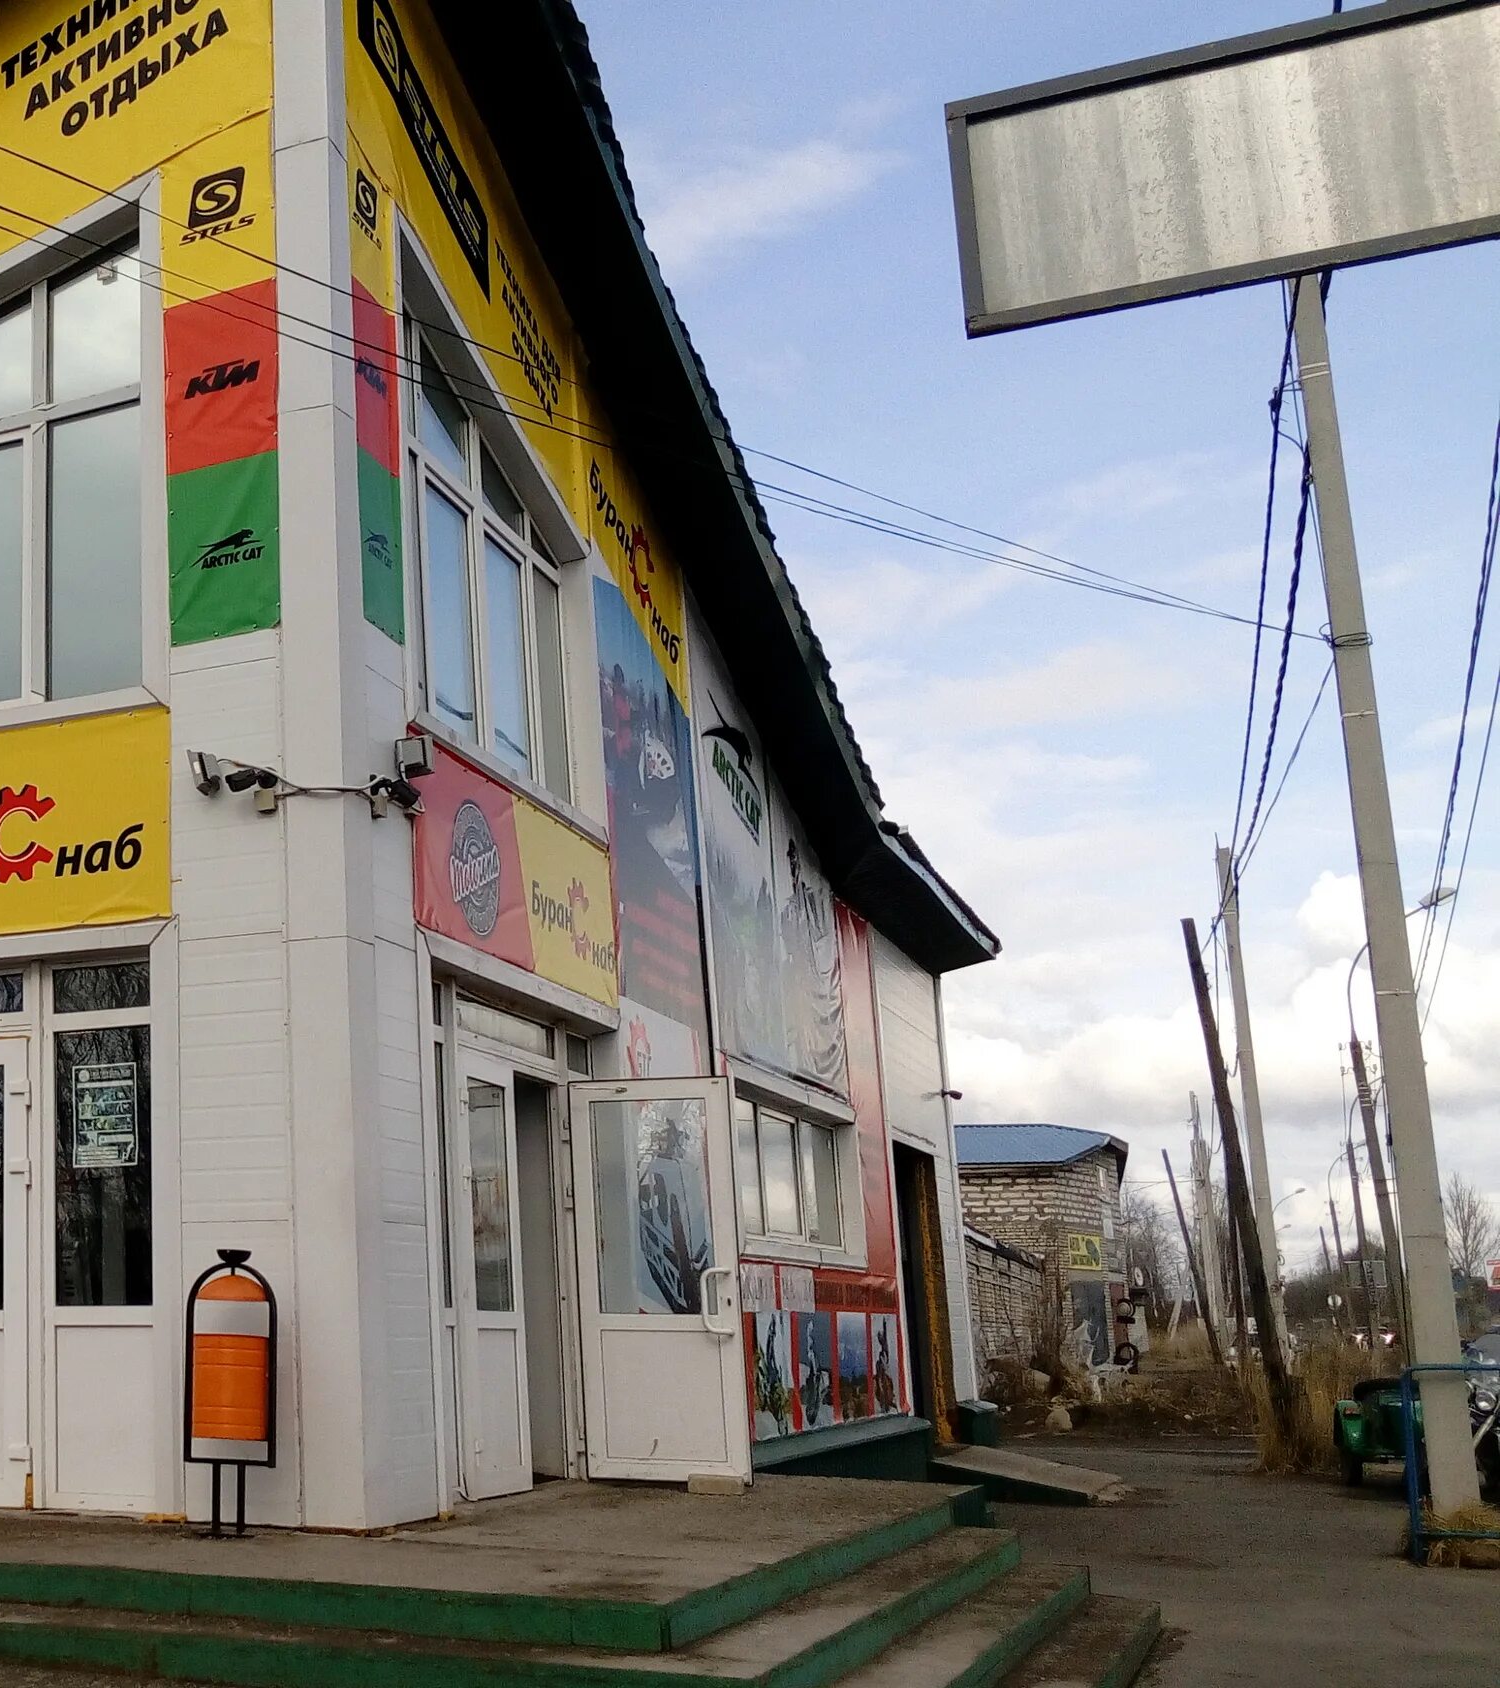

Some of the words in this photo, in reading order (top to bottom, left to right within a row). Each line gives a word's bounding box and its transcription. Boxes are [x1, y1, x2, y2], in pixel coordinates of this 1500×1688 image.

[61, 8, 229, 137] ОТДЫХА
[402, 68, 481, 245] STELS
[179, 213, 255, 247] STELS
[352, 211, 382, 251] STELS
[495, 237, 540, 343] ТЕХНИКА
[184, 359, 260, 399] KTM
[501, 283, 558, 406] АКТИВНОГО
[512, 331, 553, 425] ОТДЫХА
[201, 552, 241, 570] ARCTIC
[241, 546, 265, 569] CAT
